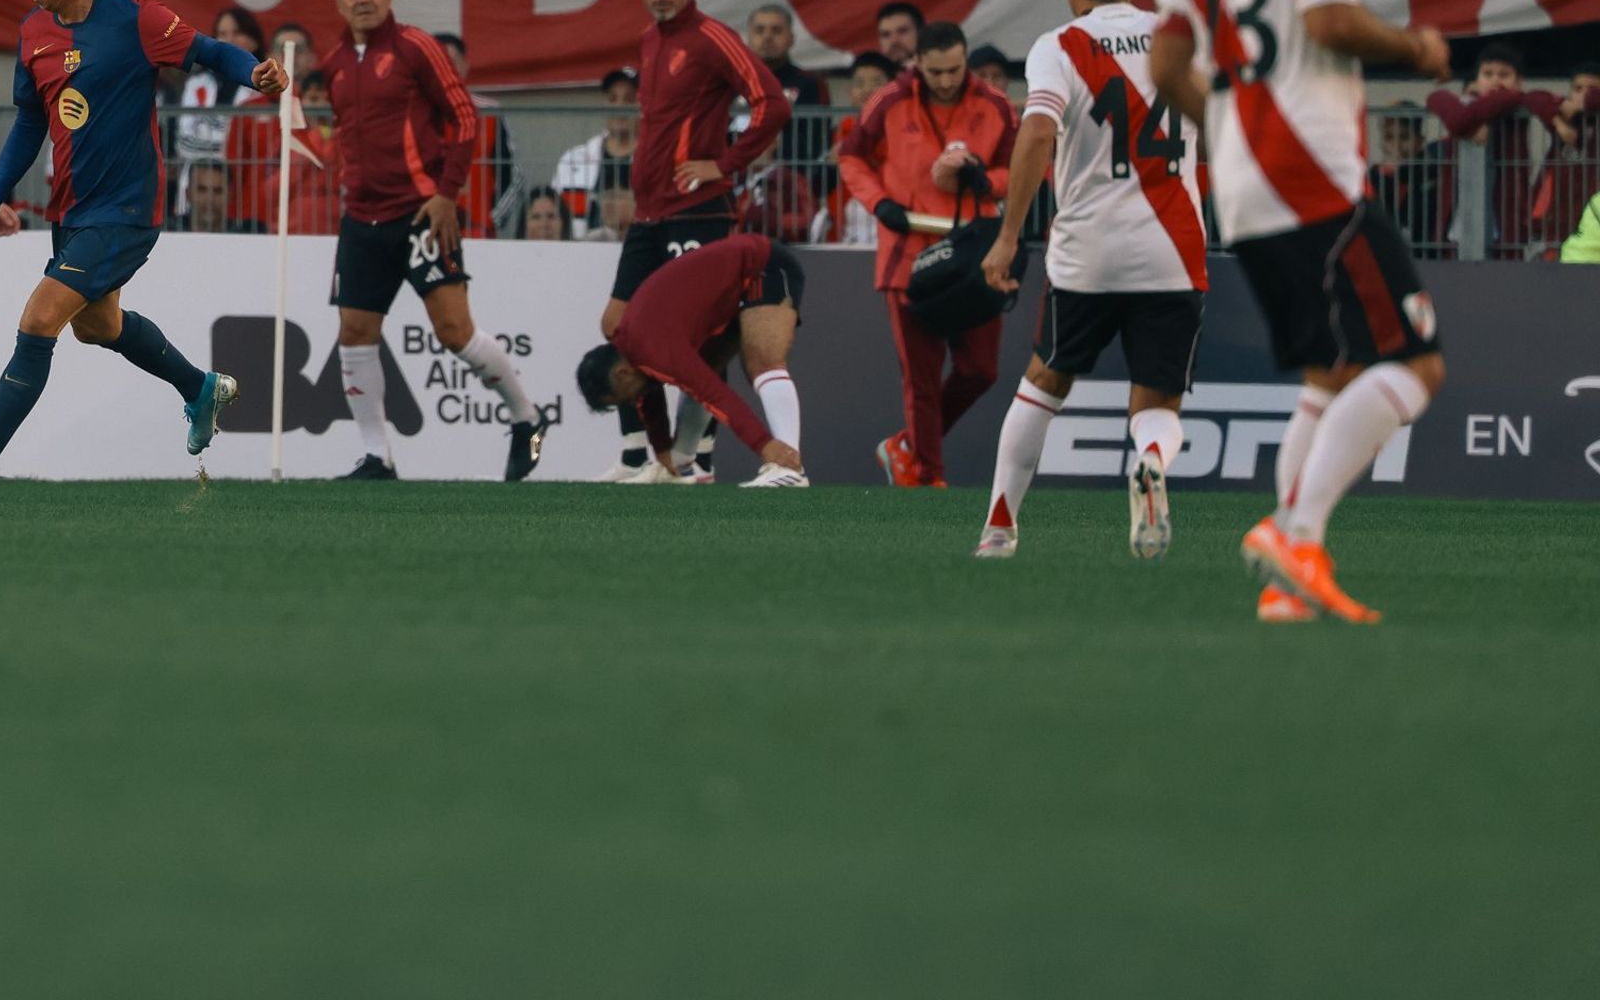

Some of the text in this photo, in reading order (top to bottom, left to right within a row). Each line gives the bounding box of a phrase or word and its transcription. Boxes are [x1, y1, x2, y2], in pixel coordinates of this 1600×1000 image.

[1090, 75, 1186, 180] 14
[408, 229, 440, 270] 20
[1466, 414, 1532, 456] EN
